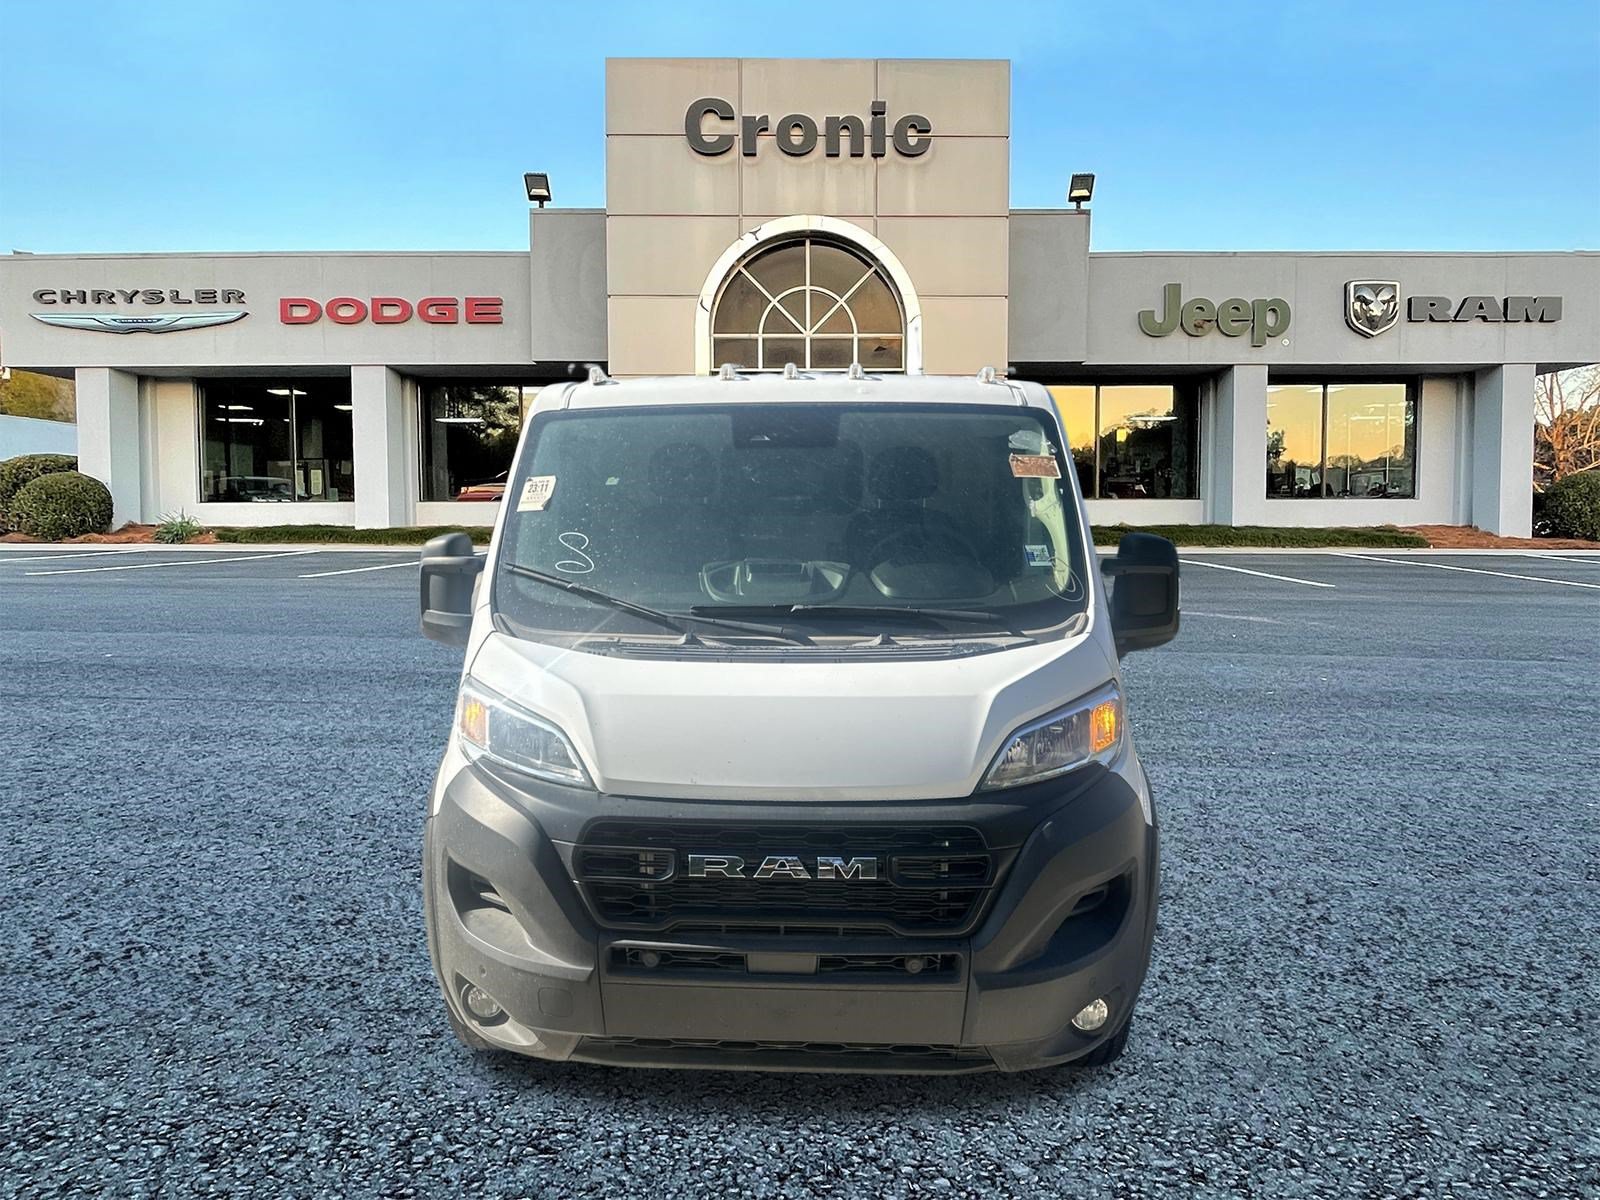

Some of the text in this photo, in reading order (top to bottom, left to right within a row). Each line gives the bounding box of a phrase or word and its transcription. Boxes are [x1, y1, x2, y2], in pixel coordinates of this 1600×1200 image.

[686, 98, 932, 157] Cronic
[32, 289, 246, 304] CHRYSLER
[1408, 296, 1562, 322] RAM
[279, 297, 503, 325] DODGE
[1138, 283, 1291, 347] Jeep
[687, 854, 878, 881] RAM
